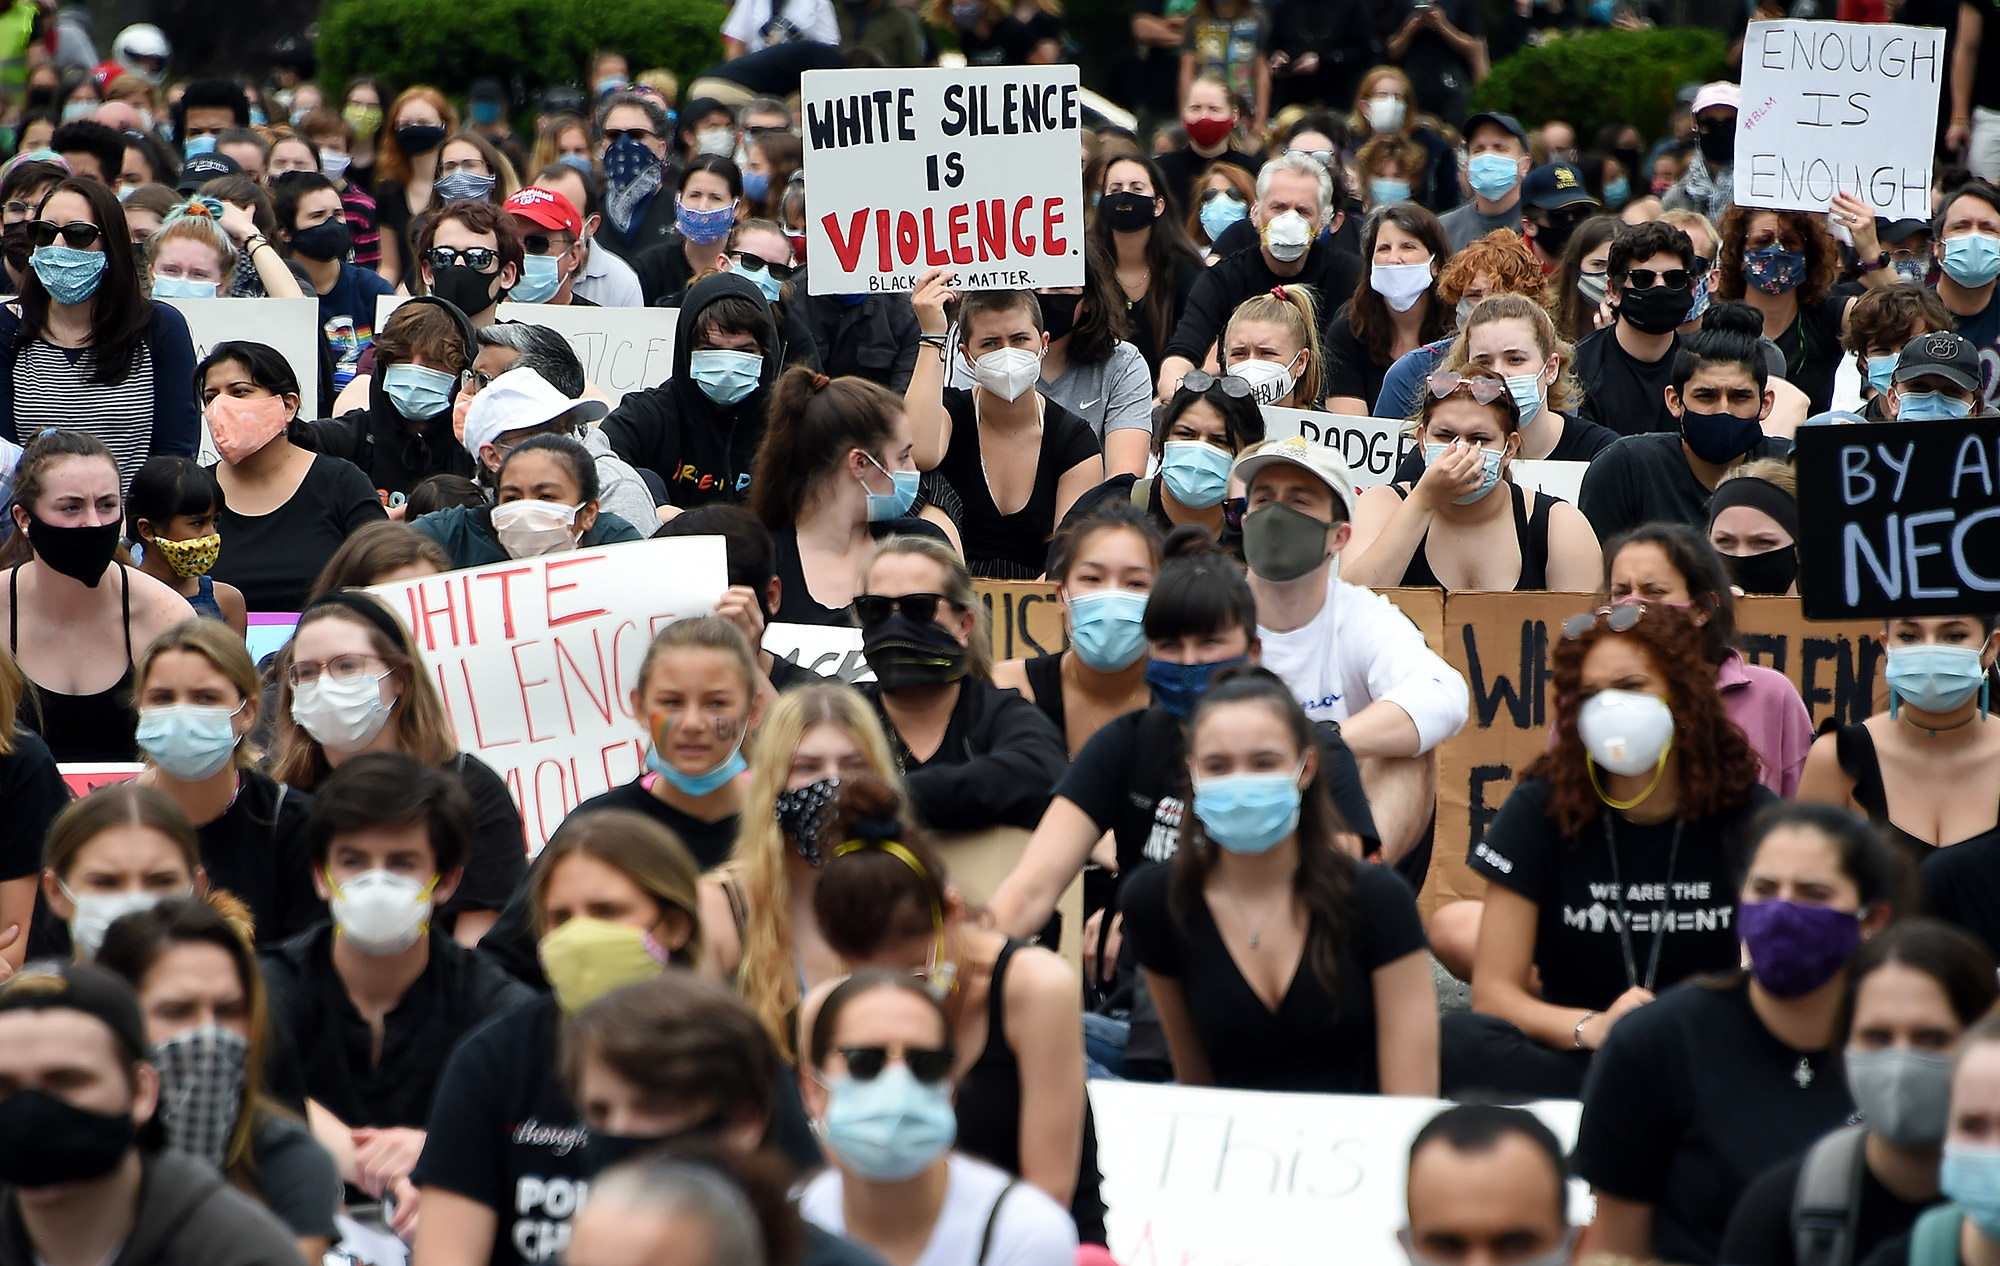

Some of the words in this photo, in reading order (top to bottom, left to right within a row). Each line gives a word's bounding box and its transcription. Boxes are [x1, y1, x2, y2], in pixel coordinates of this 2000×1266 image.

[1762, 28, 1936, 84] ENOUGH
[807, 87, 917, 151] WHITE
[940, 83, 1079, 137] SILENCE
[1743, 96, 1778, 131] #BLM
[1796, 92, 1872, 127] IS
[926, 151, 965, 192] IS
[1750, 153, 1928, 212] ENOUGH
[820, 195, 1080, 274] VIOLENCE.
[869, 275, 916, 292] BLACK
[968, 270, 1036, 287] MATTER.
[1841, 440, 1916, 506] BY
[1951, 434, 2000, 499] A
[1589, 882, 1623, 901] WE
[1627, 884, 1667, 901] ARE
[1671, 882, 1711, 900] THE
[1137, 1109, 1367, 1200] This
